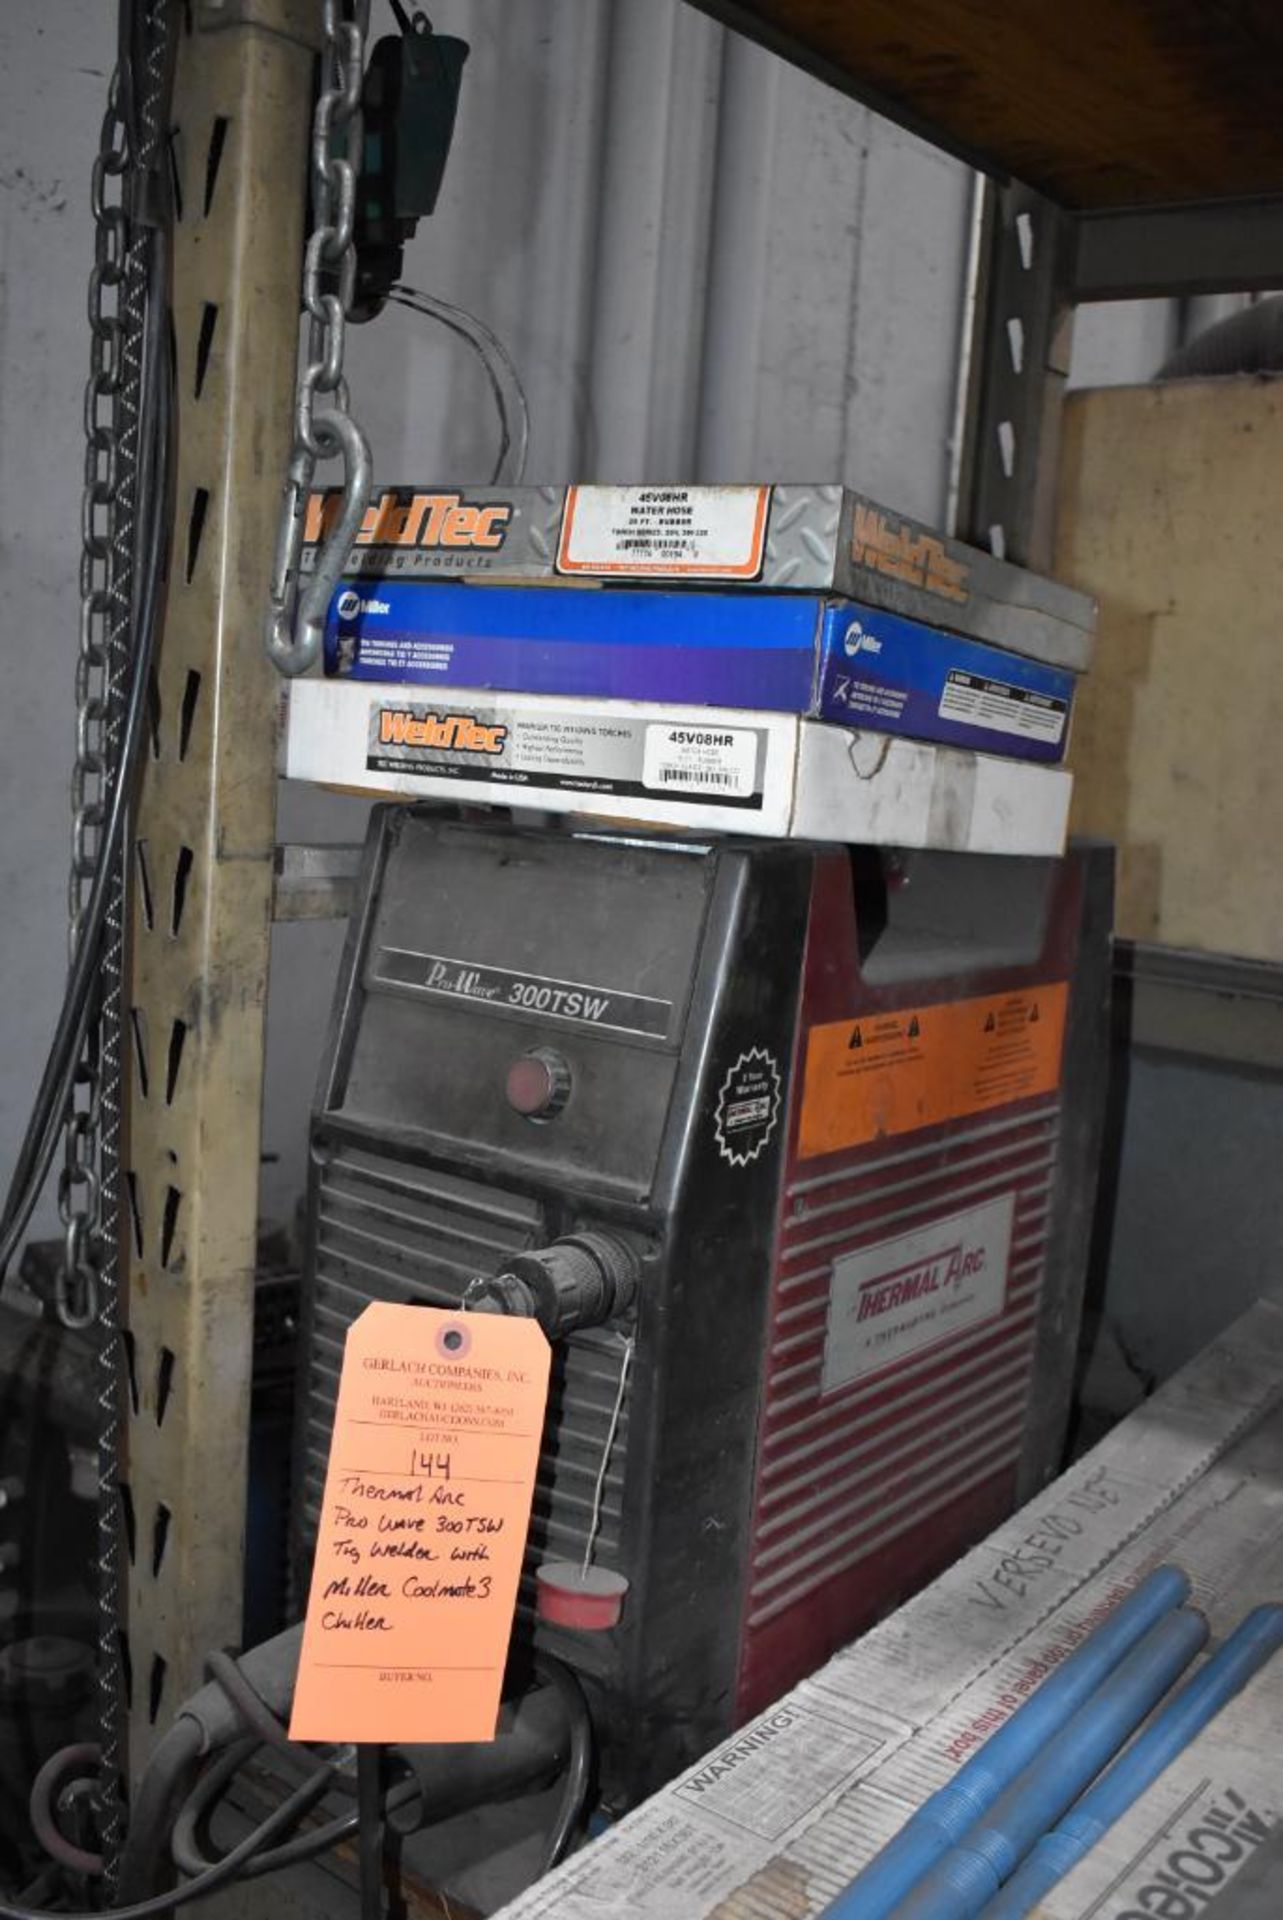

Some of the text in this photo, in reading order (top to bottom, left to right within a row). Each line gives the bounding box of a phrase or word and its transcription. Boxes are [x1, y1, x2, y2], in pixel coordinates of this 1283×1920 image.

[631, 506, 694, 516] WATER HOSE
[413, 552, 494, 570] Products
[380, 709, 507, 754] WeldTec
[668, 732, 734, 747] 45V08HR
[508, 982, 609, 1020] 300TSW
[856, 1258, 941, 1324] THERMAL
[363, 1357, 428, 1376] GERLACH
[412, 1378, 483, 1393] AUCTIONEERS
[411, 1449, 451, 1480] 144
[436, 1516, 504, 1534] 300TSW
[451, 1542, 490, 1561] with
[324, 1574, 391, 1600] Miller
[974, 1708, 1007, 1732] this
[685, 1708, 802, 1794] WARNING!
[944, 1731, 977, 1764] box!
